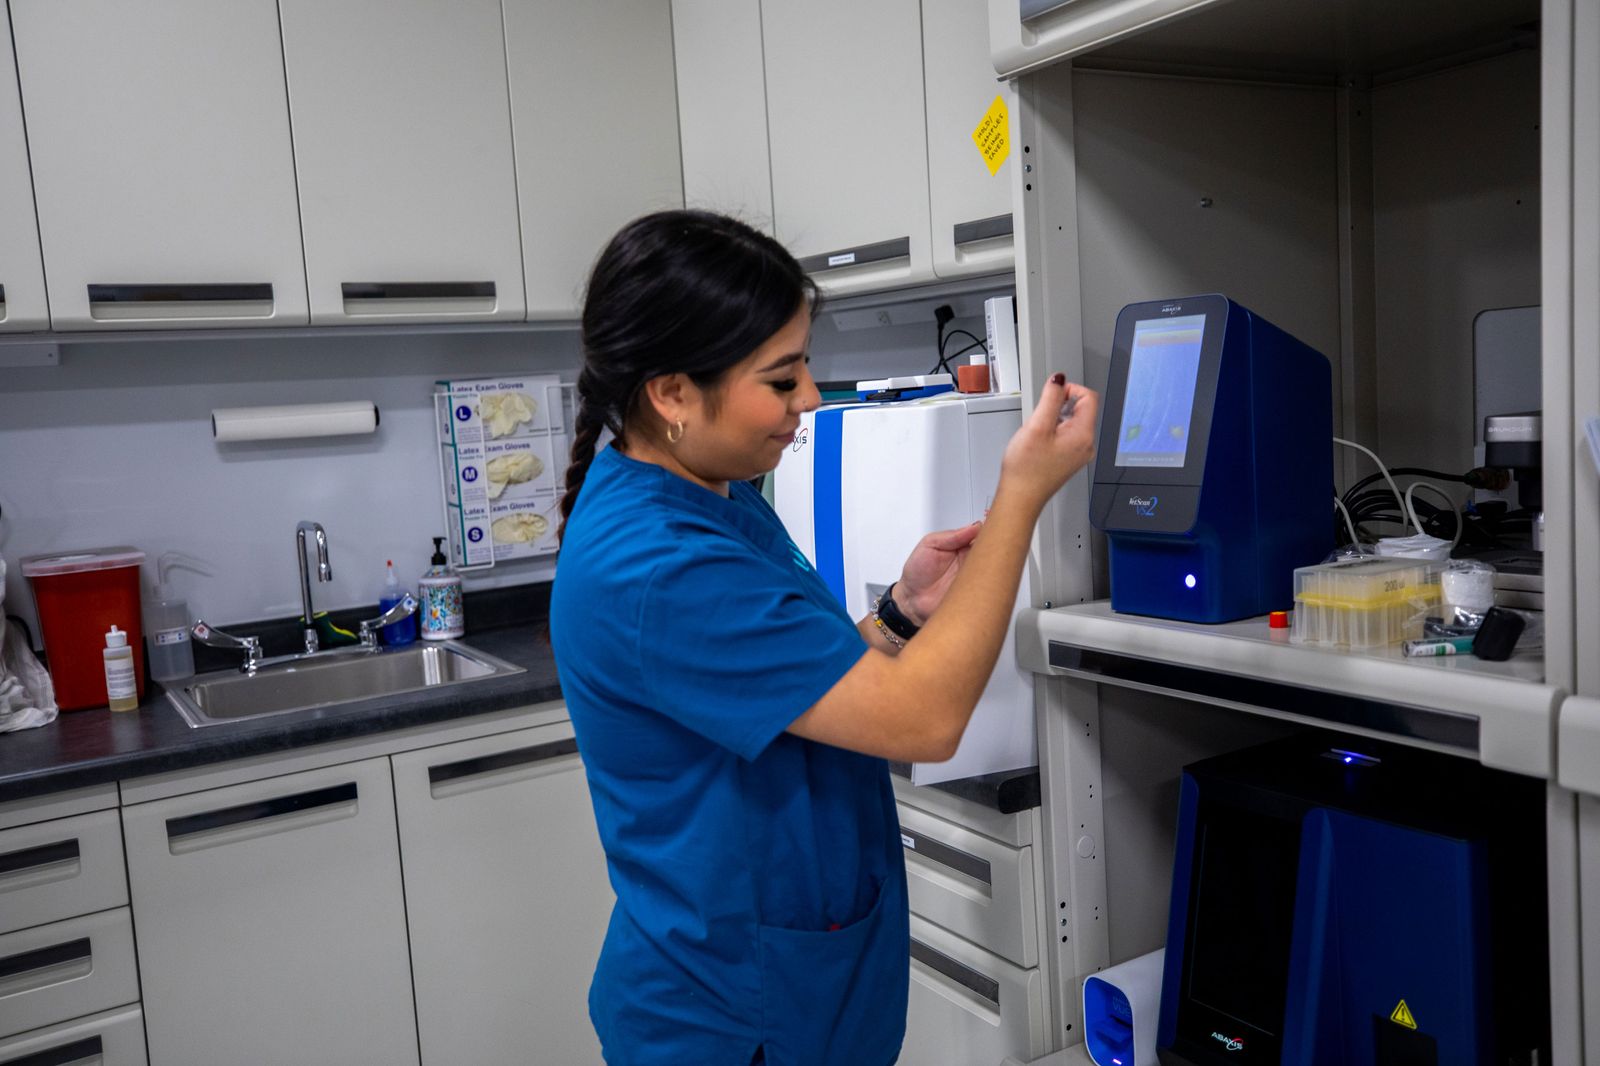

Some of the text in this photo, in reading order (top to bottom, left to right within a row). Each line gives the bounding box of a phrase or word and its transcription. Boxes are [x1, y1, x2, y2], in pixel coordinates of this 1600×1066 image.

[981, 113, 1004, 147] SAMPLES
[989, 138, 1004, 160] SAVED
[498, 382, 524, 390] Gloves
[459, 447, 479, 455] Latex
[1384, 580, 1398, 592] 200
[1211, 1032, 1243, 1050] ABAXIS
